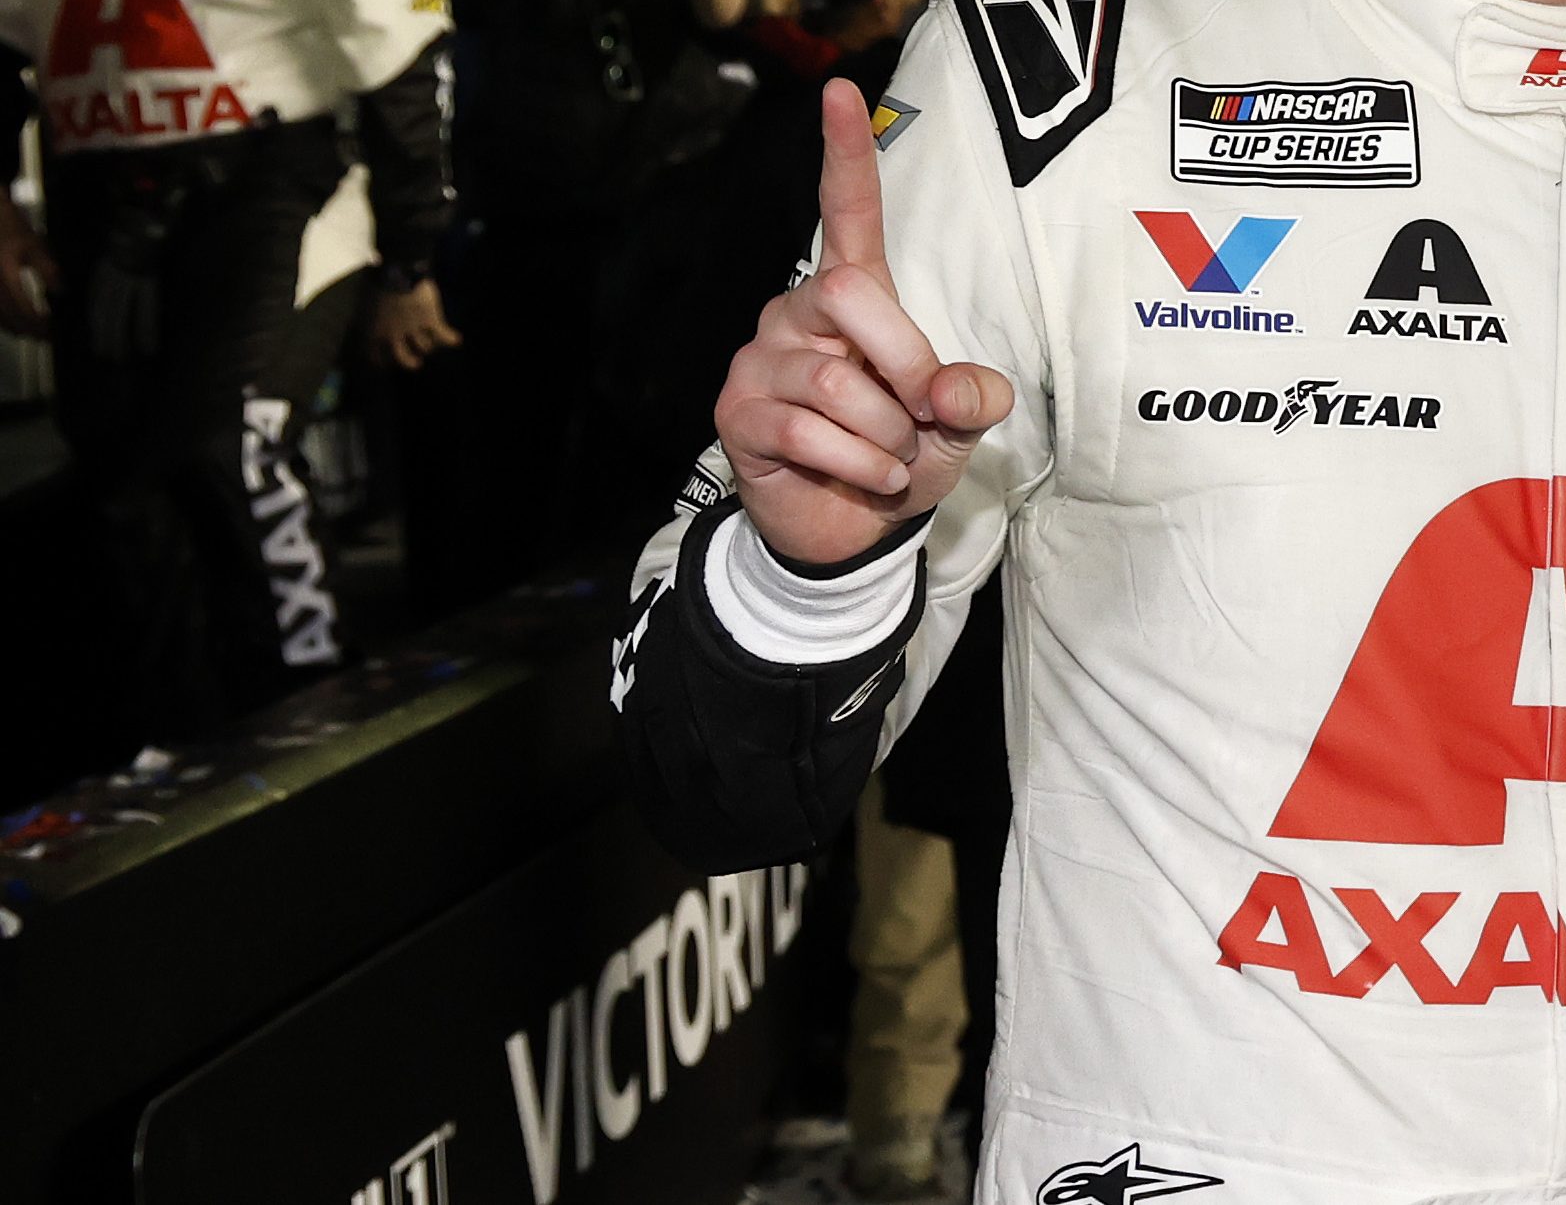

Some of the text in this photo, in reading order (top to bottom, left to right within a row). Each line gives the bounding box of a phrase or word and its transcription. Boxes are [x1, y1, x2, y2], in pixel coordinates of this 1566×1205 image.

[1251, 89, 1376, 122] NASCAR
[1208, 132, 1381, 162] CUP SERIES
[1135, 301, 1293, 334] Valvoline
[1348, 309, 1508, 343] AXALTA
[1138, 387, 1441, 430] GOODYEAR
[505, 866, 765, 1205] VICTORY
